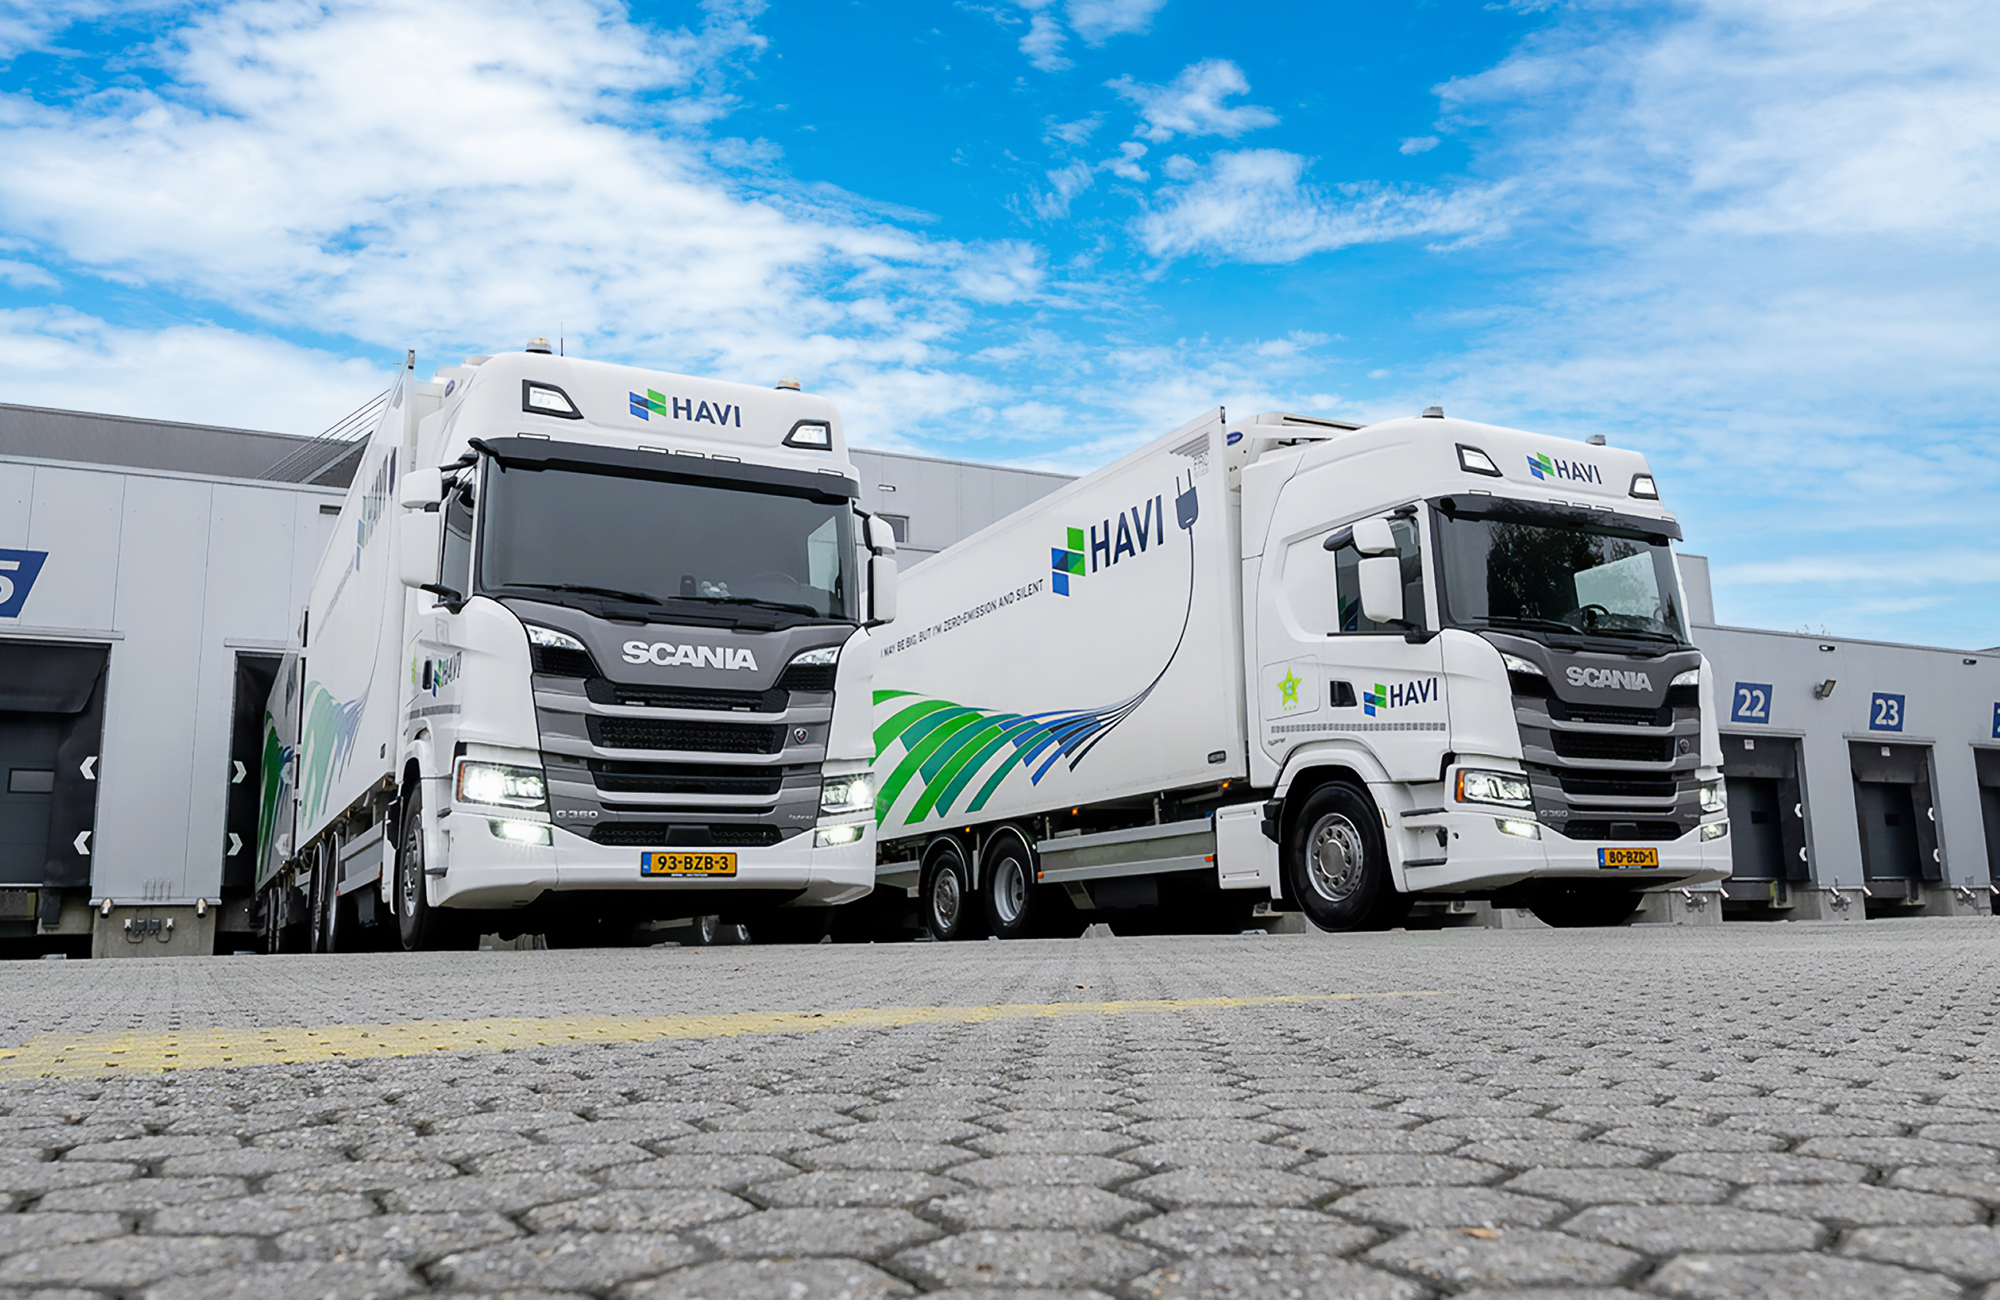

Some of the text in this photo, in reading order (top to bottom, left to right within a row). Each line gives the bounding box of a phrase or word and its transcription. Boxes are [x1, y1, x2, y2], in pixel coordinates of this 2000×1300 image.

[672, 396, 741, 428] HAVI
[1554, 458, 1602, 485] HAVI
[1090, 494, 1164, 573] HAVI
[884, 644, 896, 657] MAY
[897, 638, 905, 651] BE
[919, 627, 931, 642] BUT
[943, 599, 997, 632] ZERO-EMISSION
[999, 591, 1015, 608] AND
[1016, 578, 1044, 601] SILENT
[622, 640, 759, 671] SCANIA
[1390, 677, 1437, 708] HAVI
[1566, 666, 1653, 692] SCANIA
[1738, 688, 1766, 718] 22
[1874, 699, 1899, 726] 23
[556, 810, 567, 819] G
[657, 855, 729, 871] 93-BZB-3
[1609, 850, 1654, 864] 80-BZD-1
